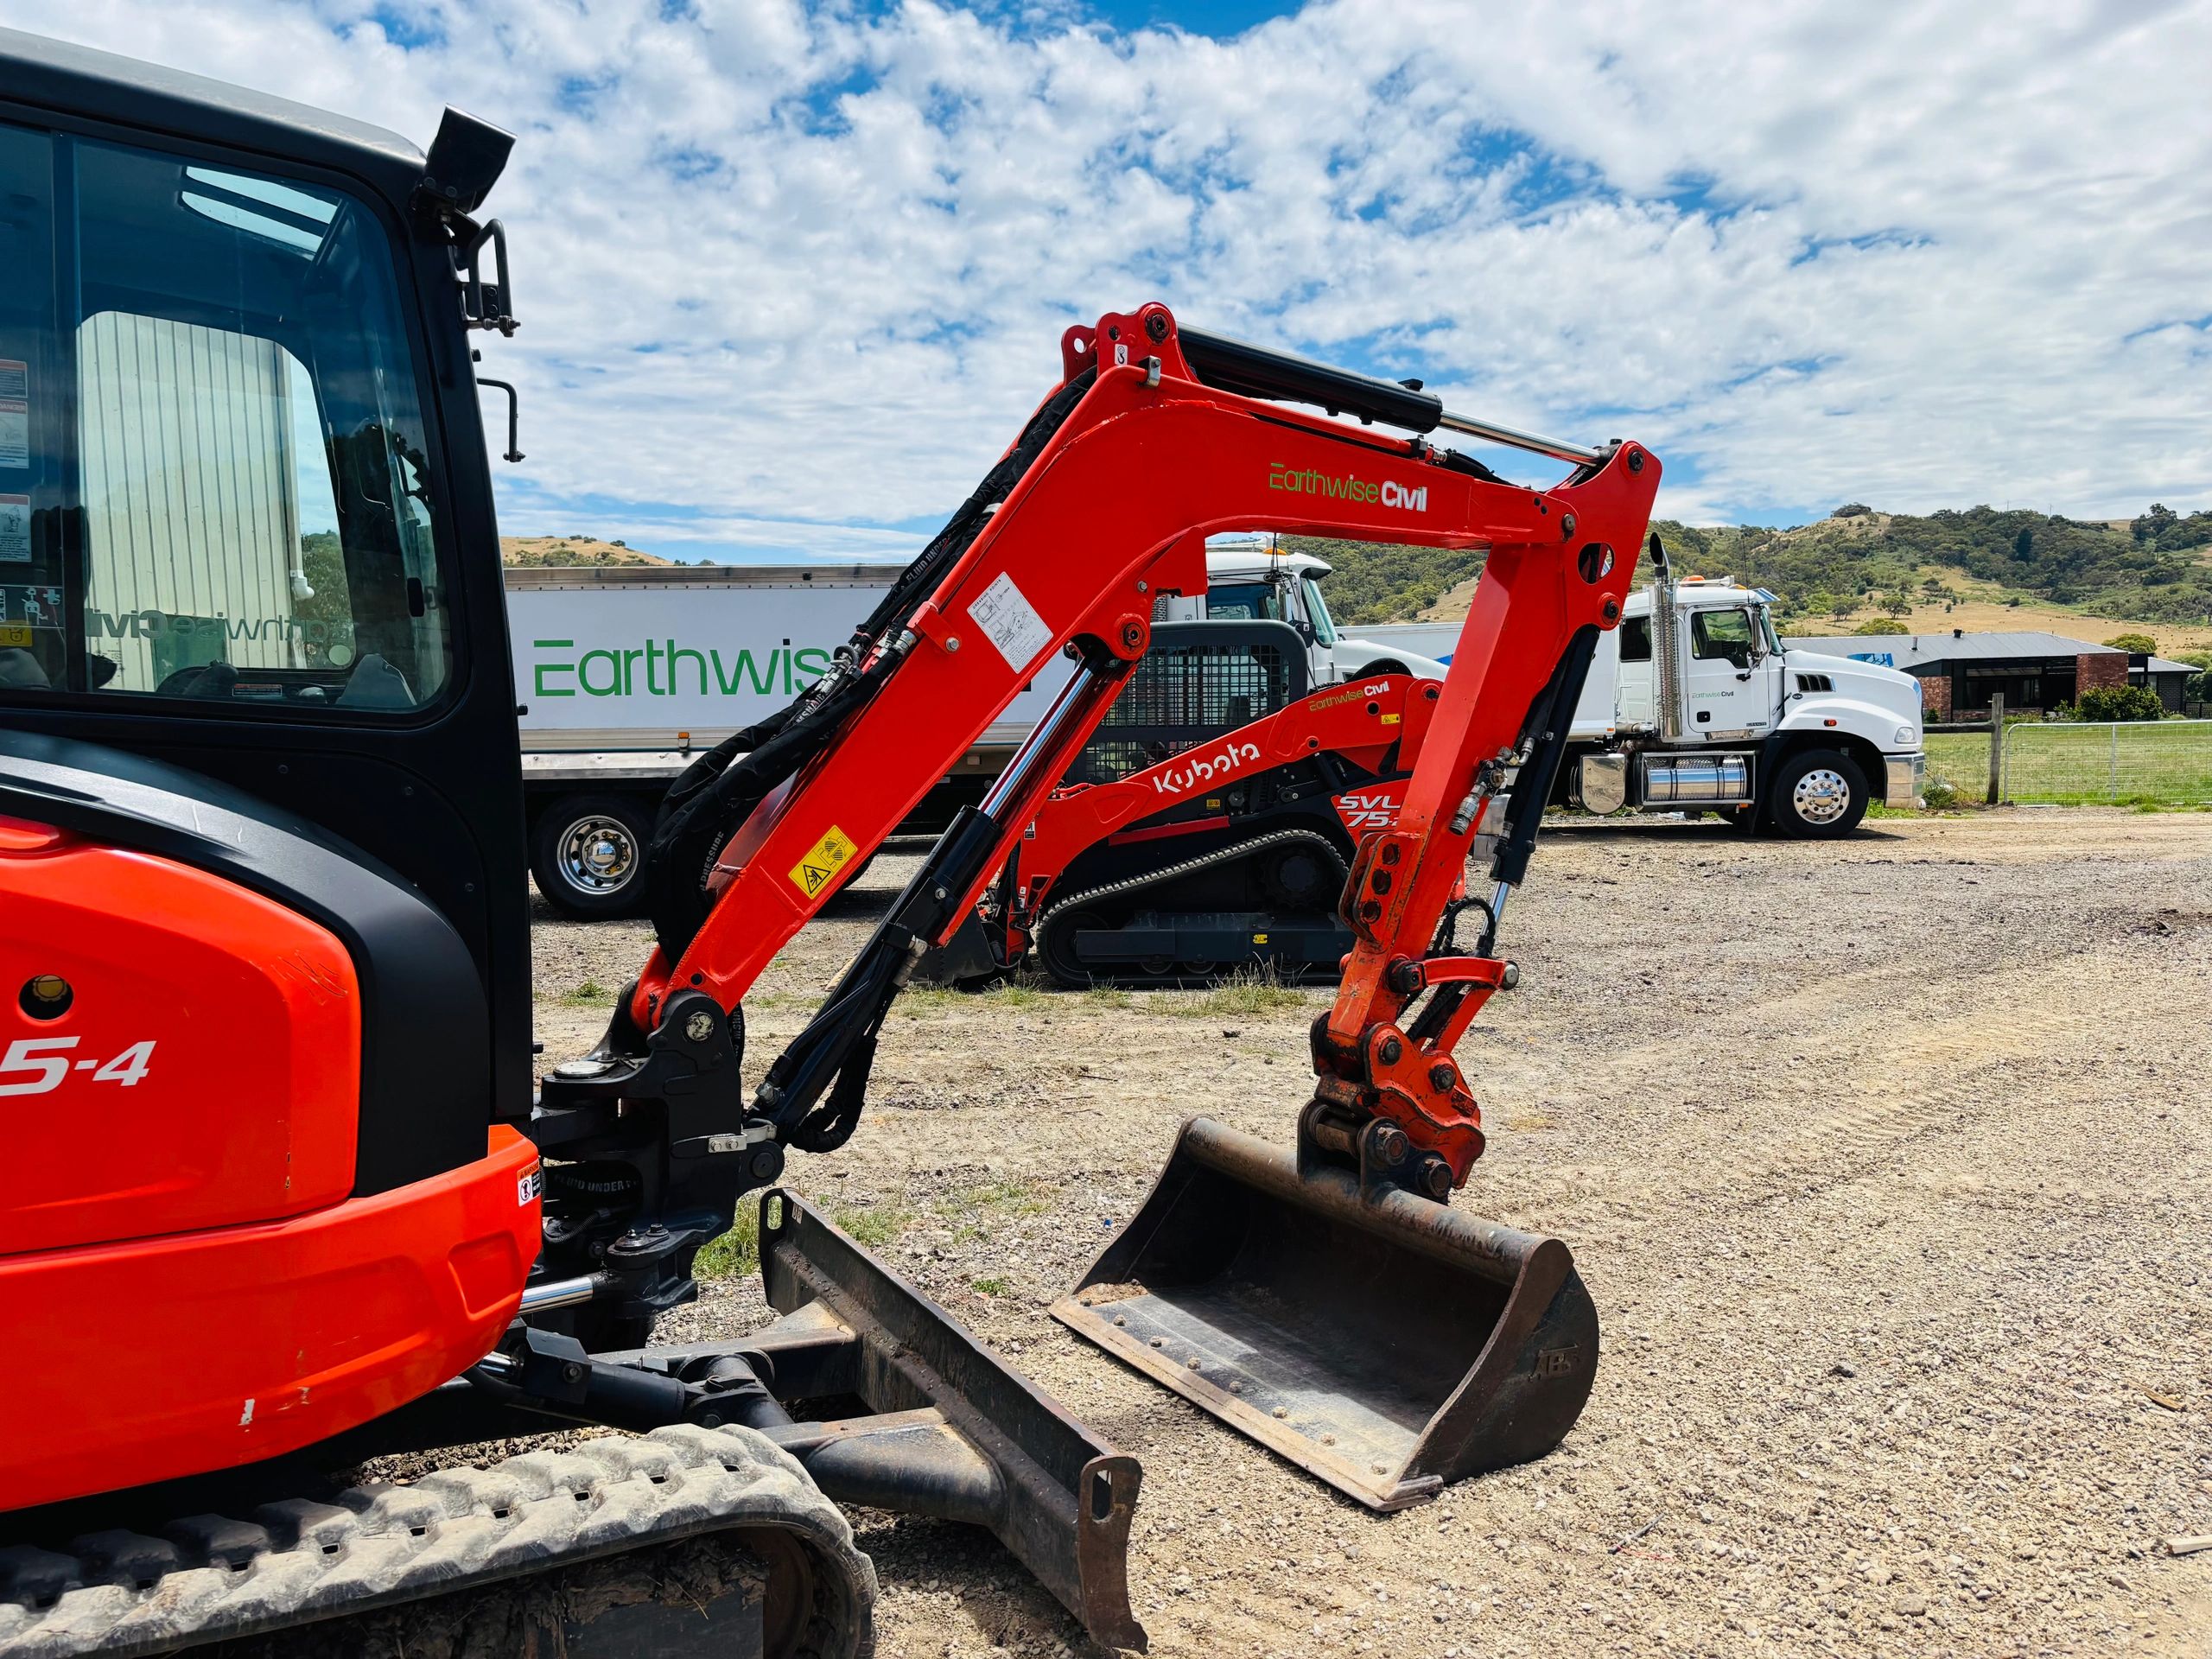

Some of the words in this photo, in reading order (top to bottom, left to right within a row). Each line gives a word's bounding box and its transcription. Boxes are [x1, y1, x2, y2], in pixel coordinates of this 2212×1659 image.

[1269, 462, 1380, 504] Earthwise
[1381, 480, 1427, 512] Civil
[533, 638, 832, 697] Earthwis
[1308, 690, 1364, 711] Earthwise
[1363, 680, 1390, 696] Civil
[1153, 742, 1261, 793] Kubota
[1337, 795, 1401, 810] SVL
